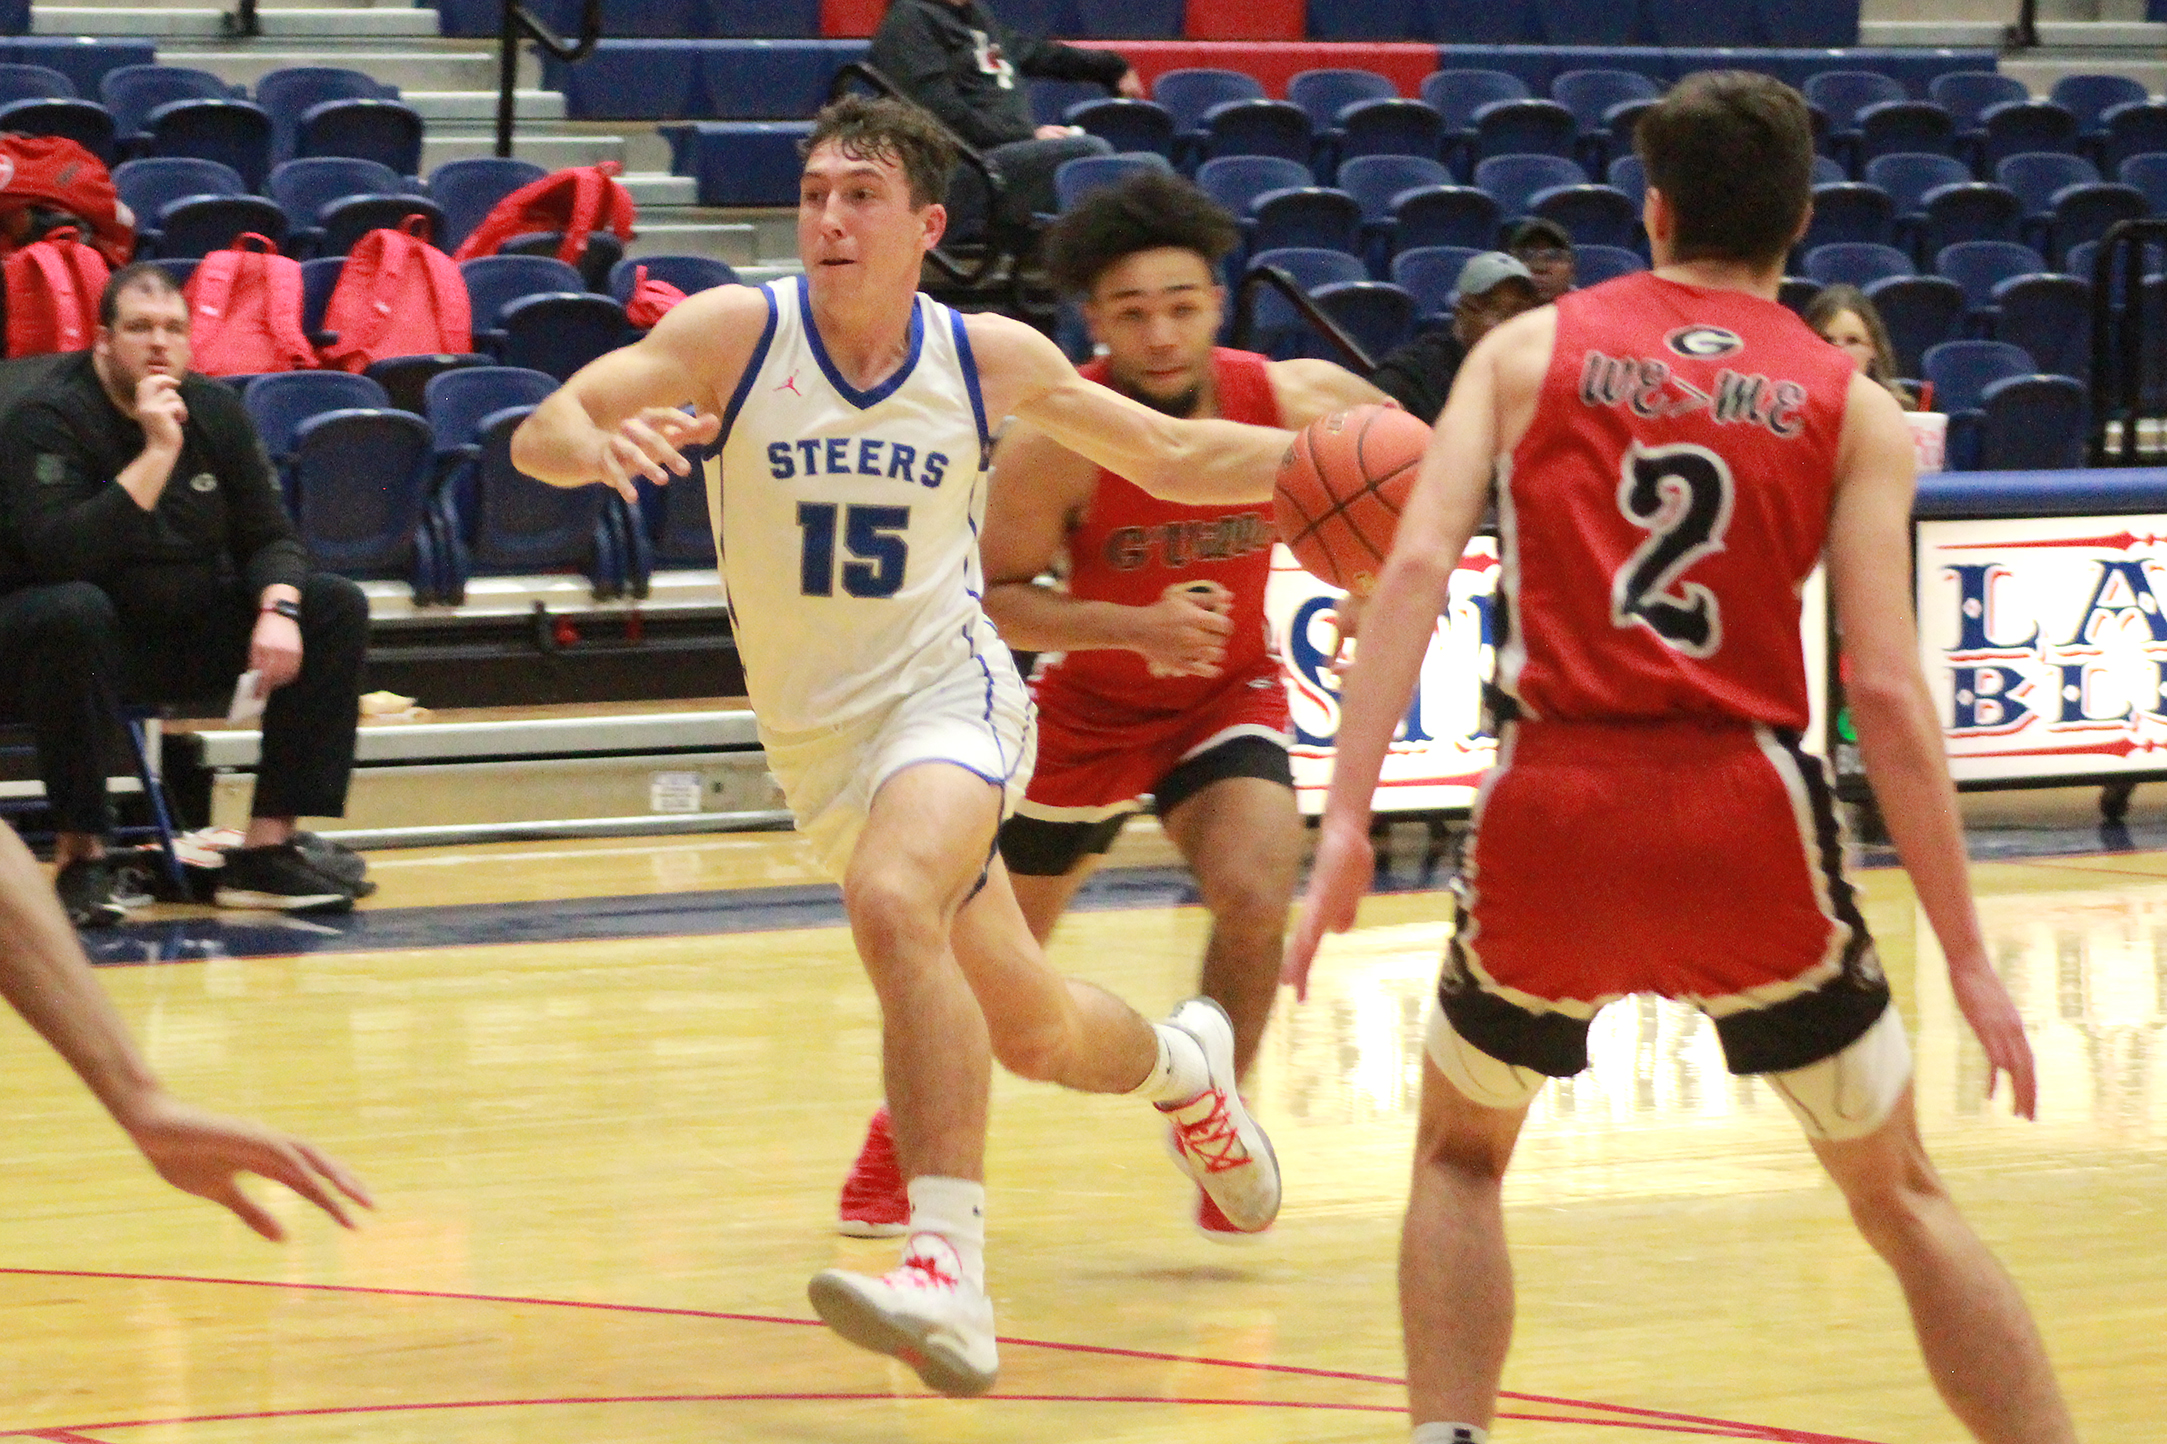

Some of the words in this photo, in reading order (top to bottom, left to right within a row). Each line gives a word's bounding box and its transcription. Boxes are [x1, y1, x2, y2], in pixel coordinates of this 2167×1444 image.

[767, 437, 950, 489] STEERS
[795, 500, 912, 600] 15
[1611, 440, 1736, 659] 2
[1942, 659, 2167, 730] BL
